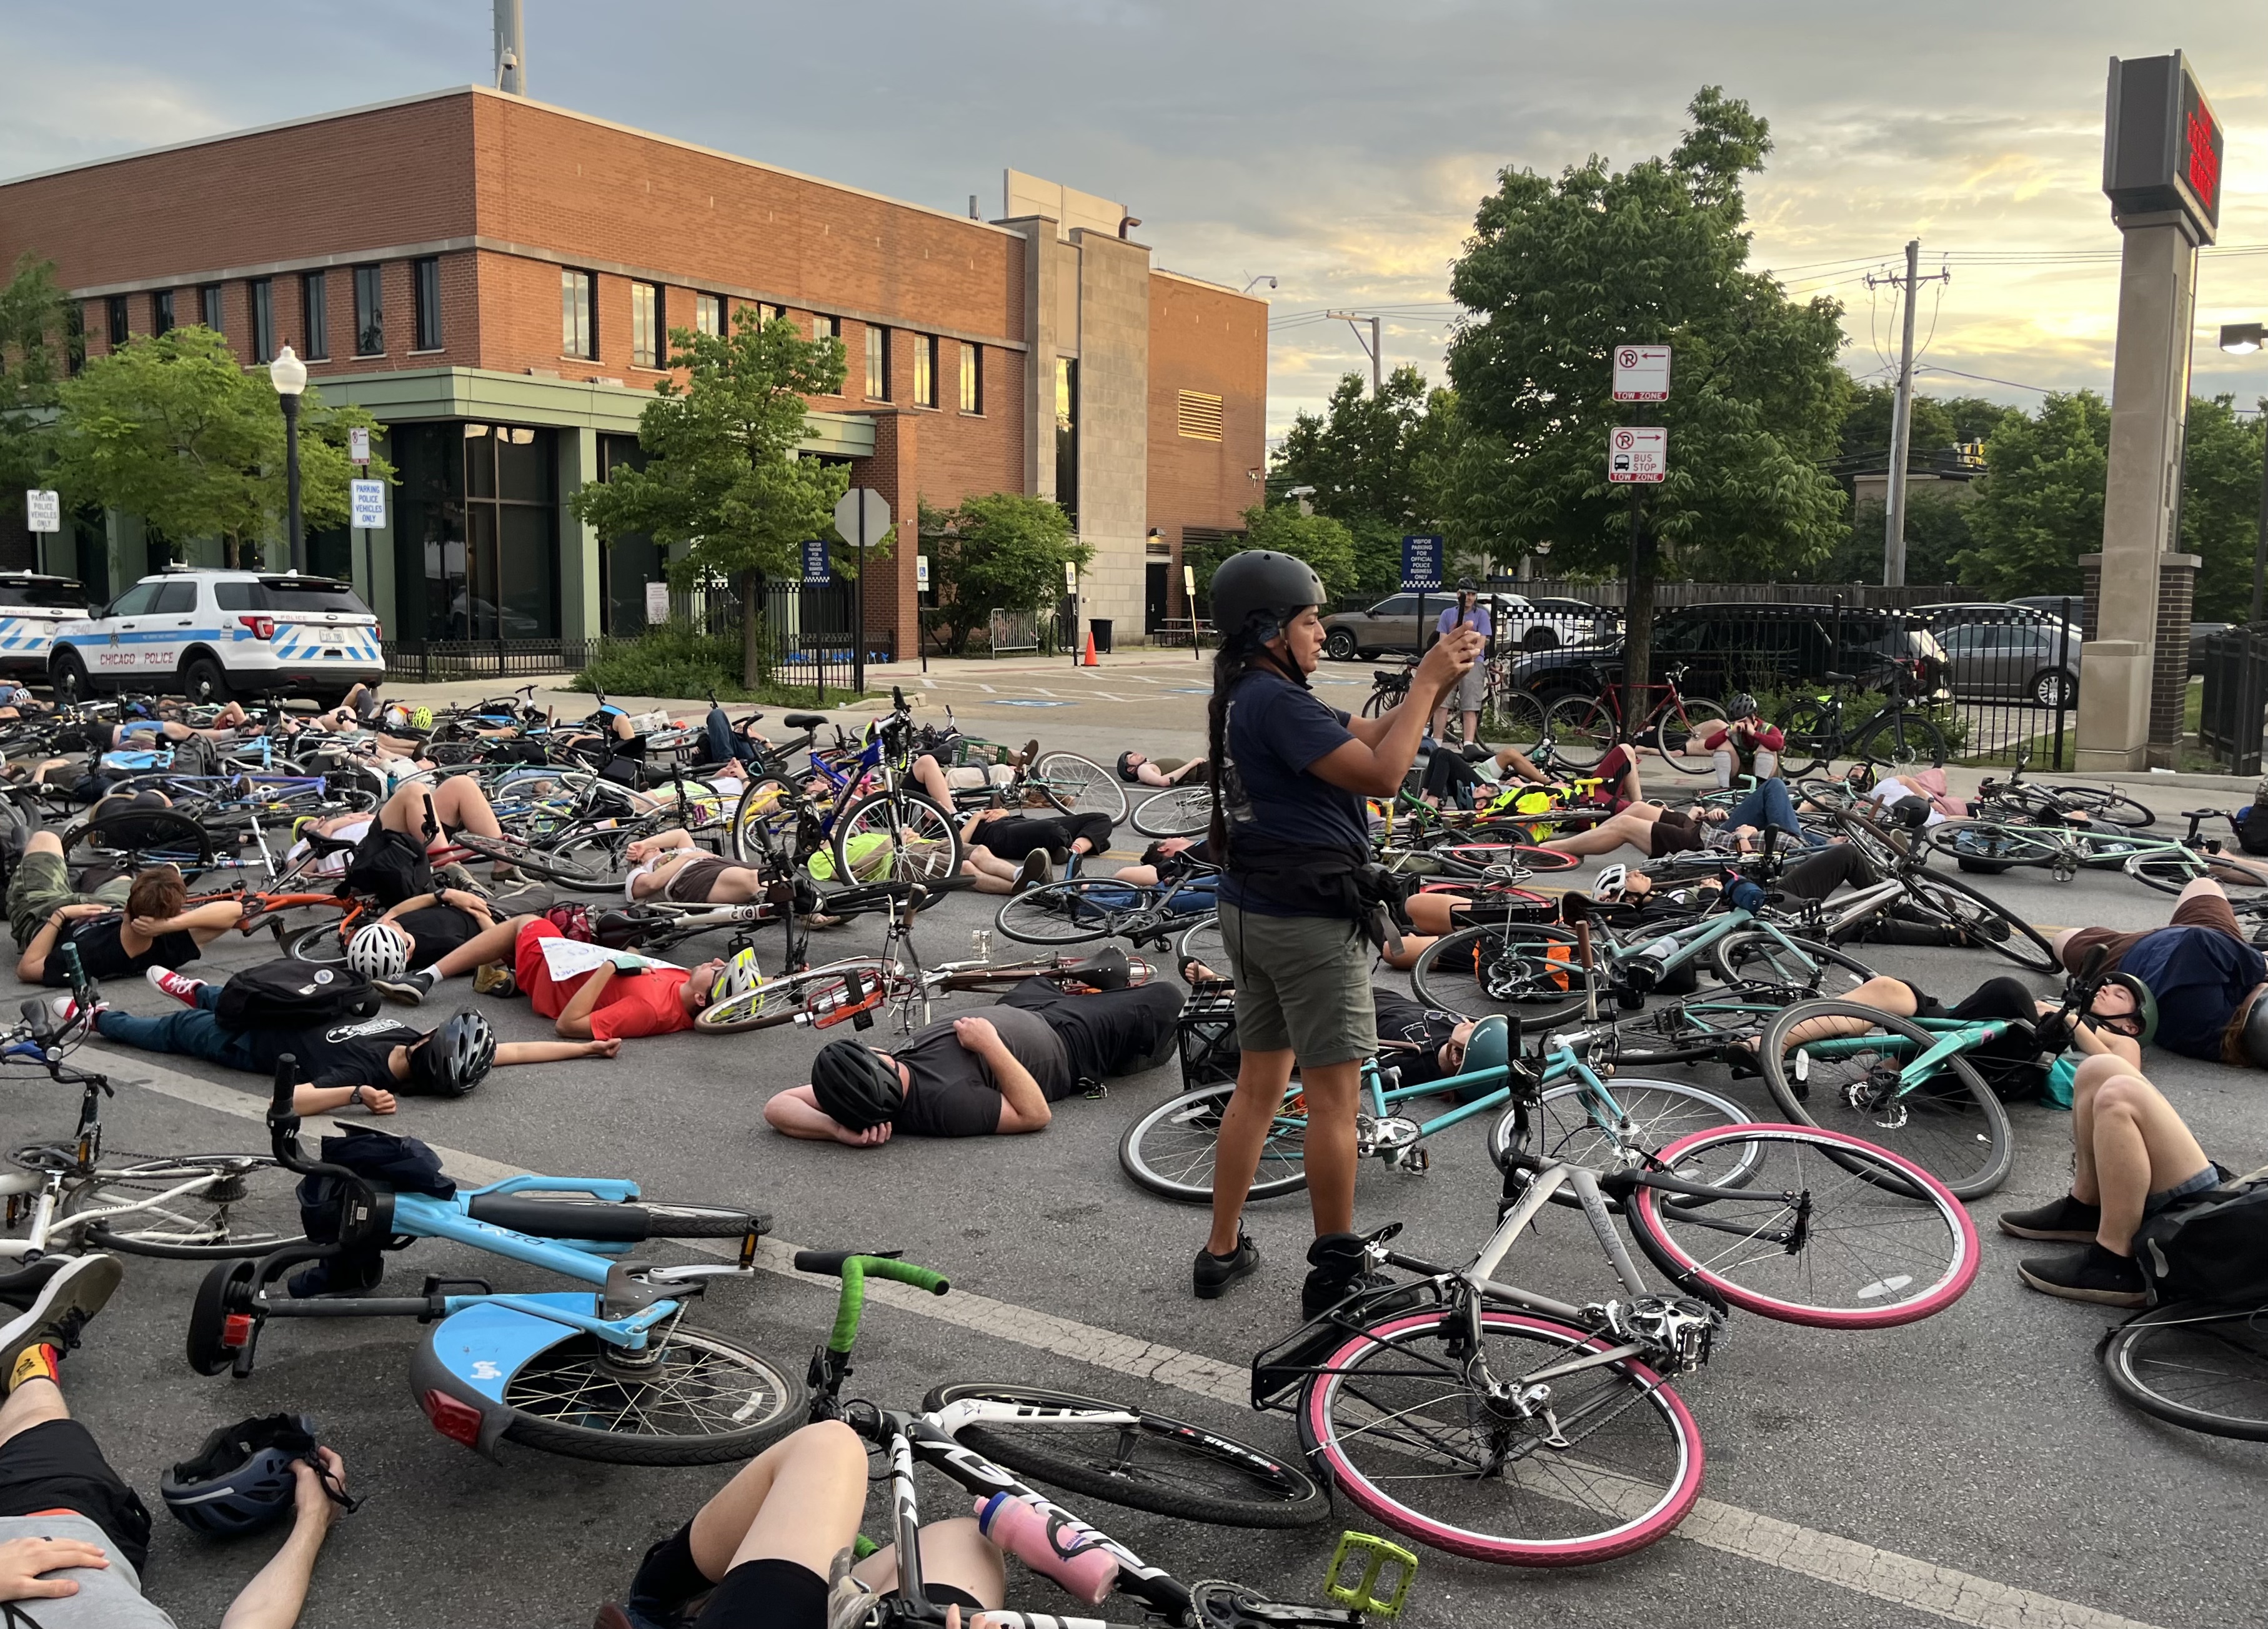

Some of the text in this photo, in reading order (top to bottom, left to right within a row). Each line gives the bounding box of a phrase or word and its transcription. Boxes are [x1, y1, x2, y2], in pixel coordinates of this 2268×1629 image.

[1634, 454, 1653, 462] BUS
[1633, 463, 1657, 472] STOP
[356, 485, 380, 493] PARKING
[31, 494, 55, 502] PARKING
[359, 495, 379, 503] POLICE
[356, 505, 382, 513] VEHICLES
[31, 511, 57, 519] VEHICLES
[362, 514, 376, 523] ONLY
[101, 651, 174, 665] CHICAGO POLICE
[1584, 1196, 1621, 1255] TREK
[470, 1360, 502, 1379] lyft
